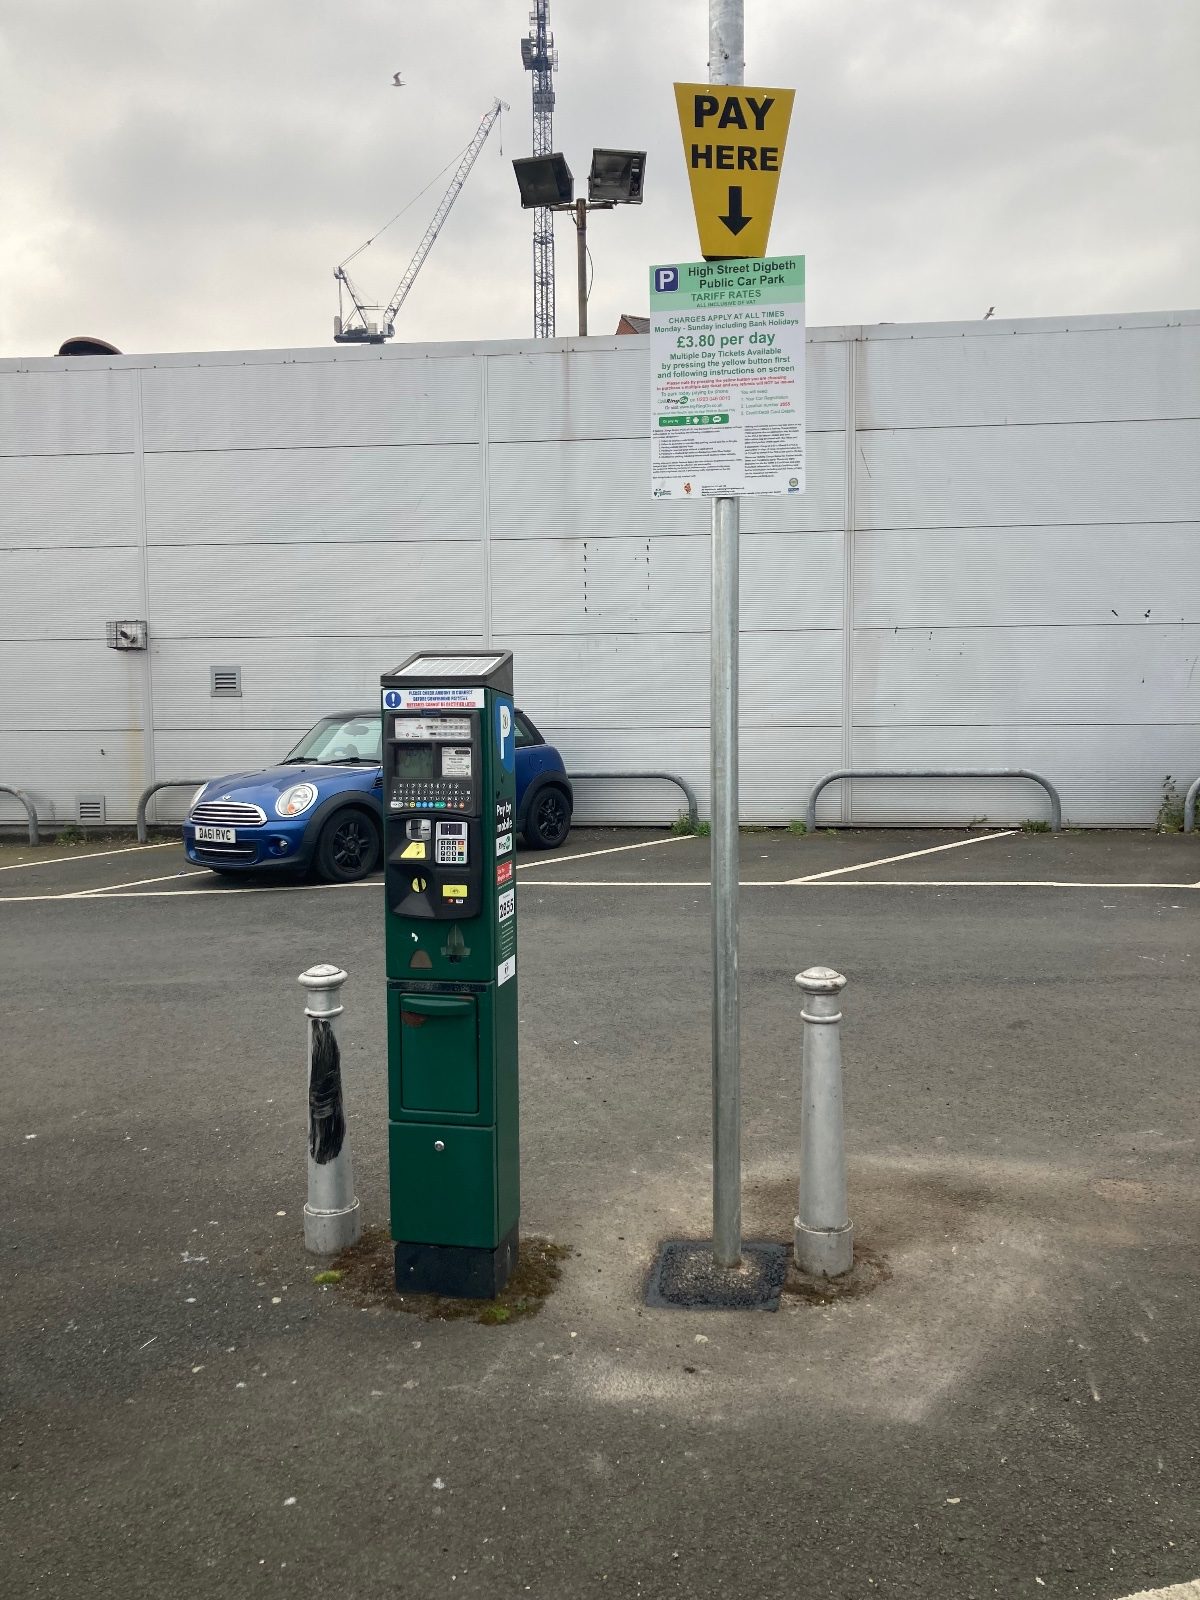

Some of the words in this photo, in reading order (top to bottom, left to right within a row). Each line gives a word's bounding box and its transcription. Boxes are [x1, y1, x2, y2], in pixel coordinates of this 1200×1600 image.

[695, 95, 776, 130] PAY
[692, 144, 778, 171] HERE
[689, 264, 713, 278] High
[717, 263, 749, 275] Street
[753, 261, 796, 274] Digbeth
[700, 278, 733, 288] Public
[738, 277, 756, 286] Car
[760, 275, 785, 284] Park
[691, 292, 725, 302] TARIFF
[729, 289, 761, 299] RATES
[715, 322, 747, 330] including
[769, 319, 798, 327] Holidays
[677, 335, 715, 348] £3.80
[721, 335, 744, 348] per
[749, 332, 776, 345] day
[670, 352, 699, 360] Multiple
[673, 361, 706, 370] pressing
[722, 358, 746, 367] yellow
[673, 369, 708, 377] following
[710, 367, 754, 375] instructions
[497, 804, 505, 817] Pay
[506, 802, 511, 815] by
[497, 817, 512, 832] mobile
